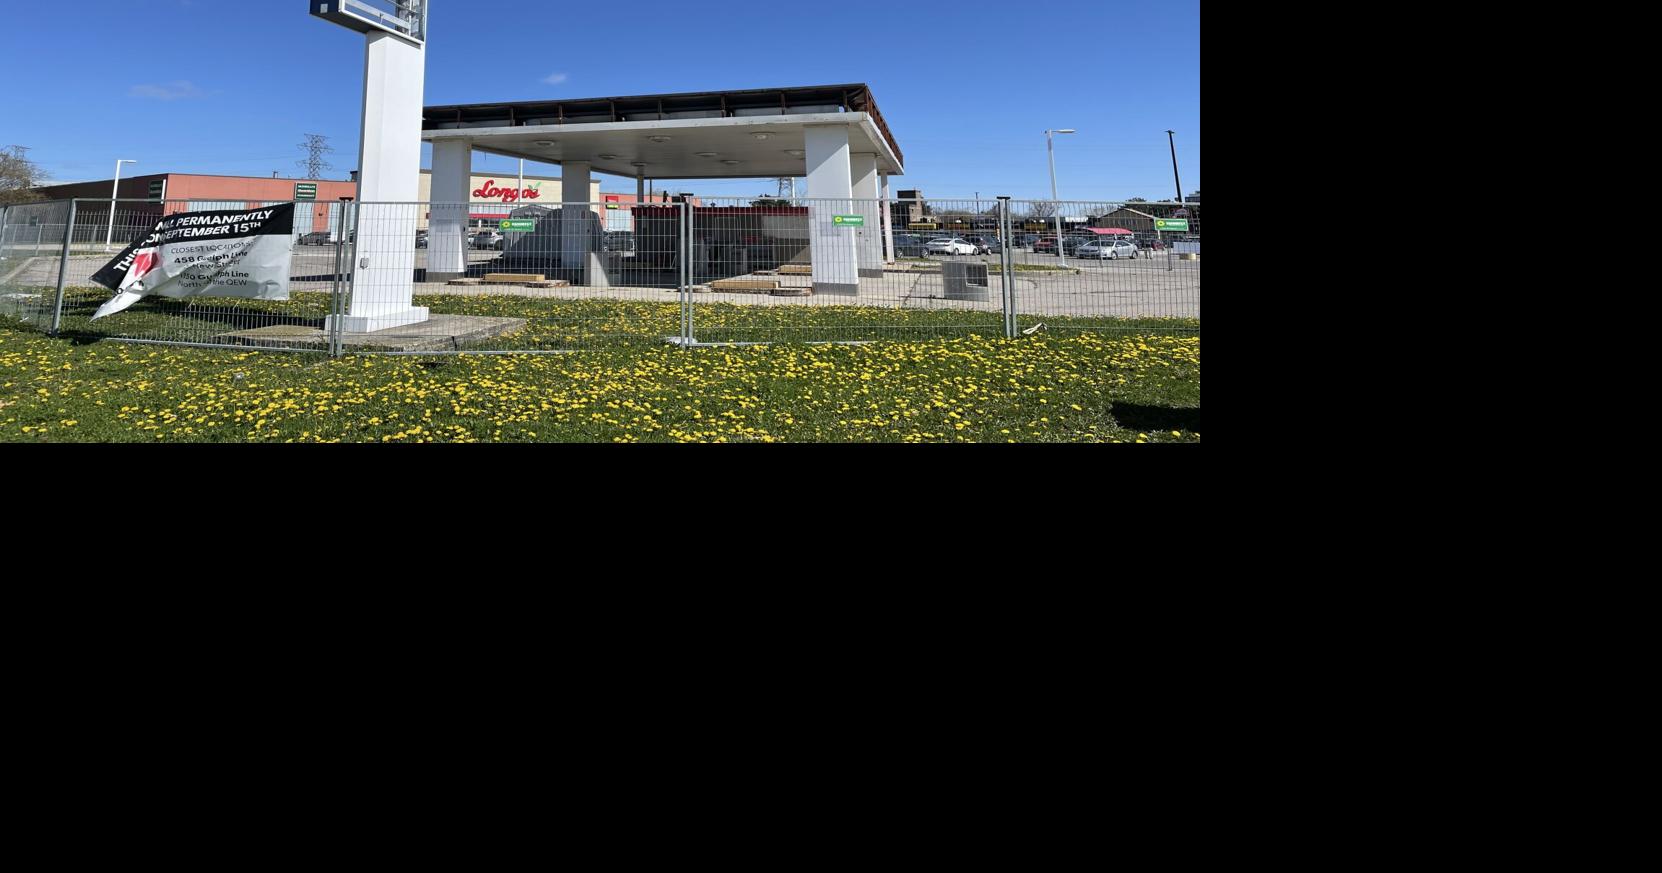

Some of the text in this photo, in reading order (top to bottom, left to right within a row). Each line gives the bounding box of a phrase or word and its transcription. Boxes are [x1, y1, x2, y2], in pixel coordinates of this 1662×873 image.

[176, 210, 274, 227] PERMANENTLY
[233, 222, 261, 233] 15TH
[174, 256, 195, 264] 458
[197, 270, 230, 280] Gulph
[231, 270, 249, 278] Line
